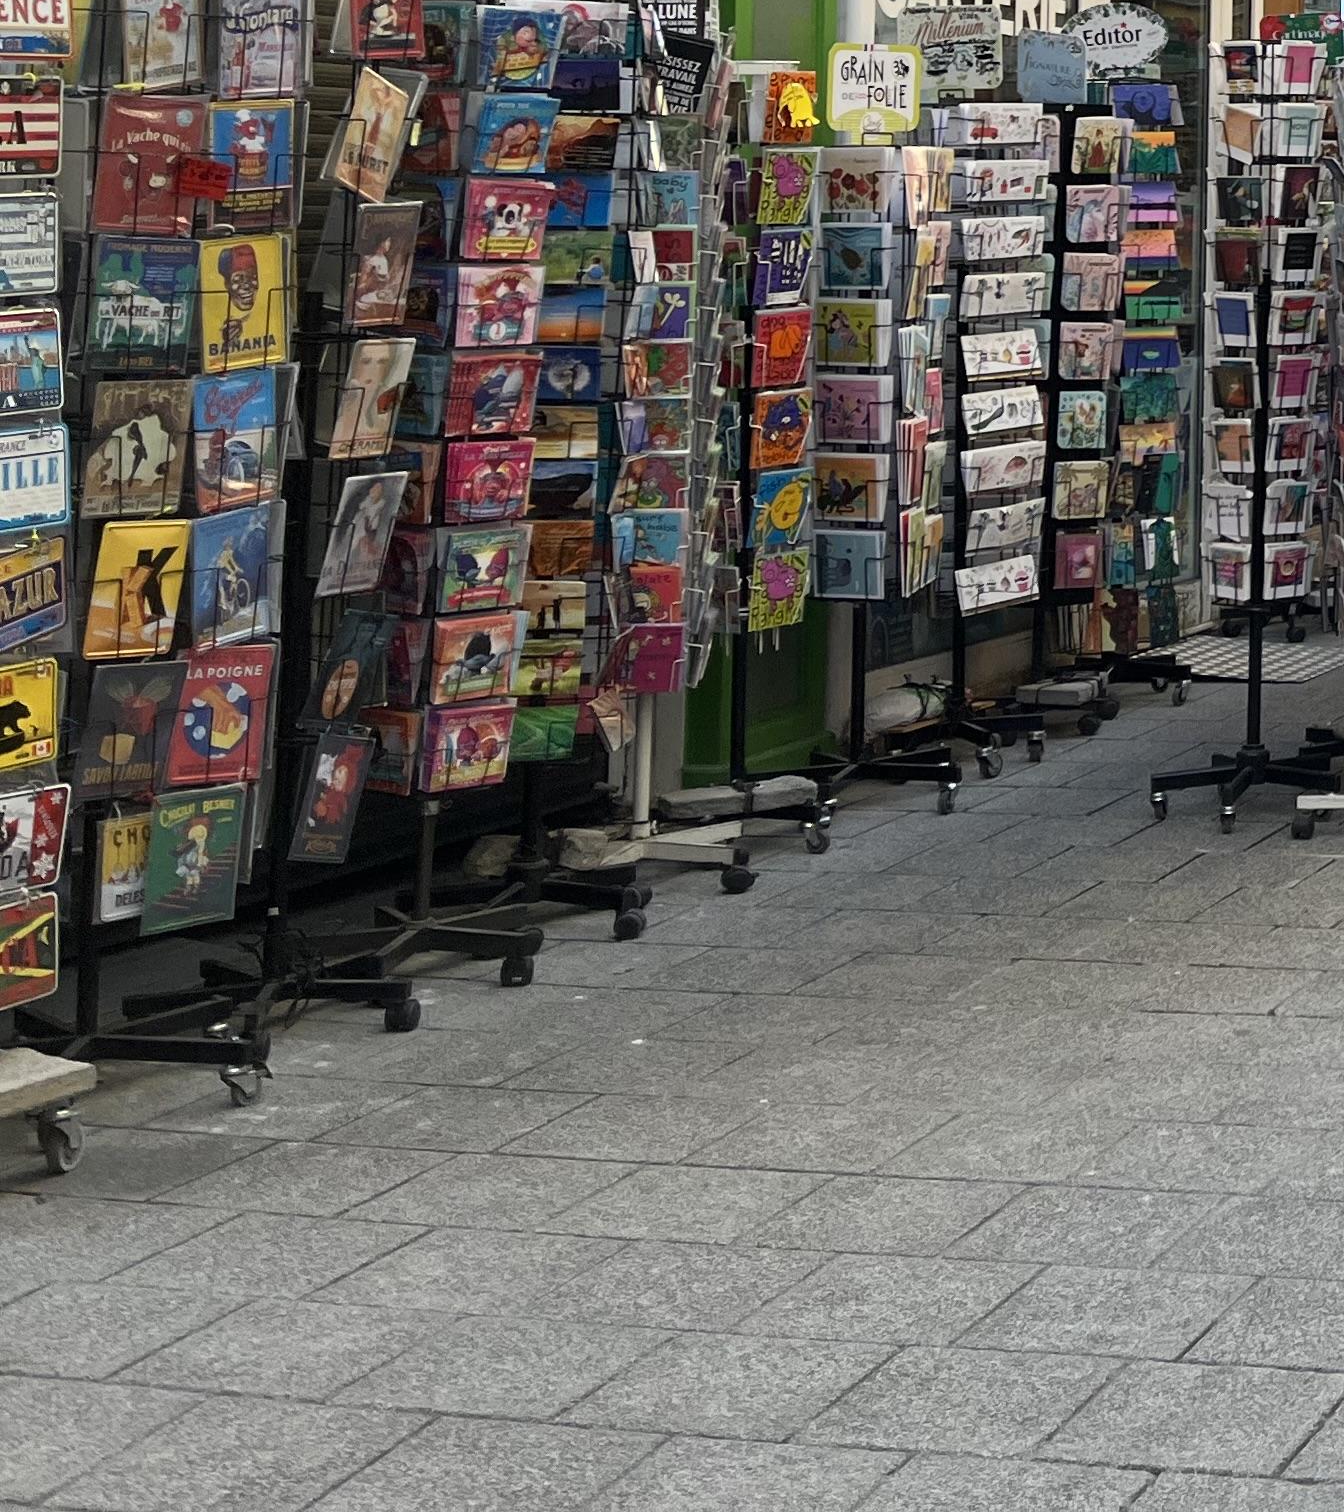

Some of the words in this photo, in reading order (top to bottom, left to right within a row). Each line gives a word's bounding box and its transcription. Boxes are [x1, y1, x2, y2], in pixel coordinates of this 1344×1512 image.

[658, 4, 698, 20] LUNE
[1084, 26, 1143, 48] Editor
[840, 52, 885, 85] GRAIN
[867, 83, 907, 109] FOLIE
[126, 128, 160, 144] Vache
[162, 134, 180, 147] qui
[111, 304, 149, 317] VACHE
[208, 335, 277, 357] BANANIA
[186, 668, 203, 680] LA
[207, 664, 264, 679] POIGNE
